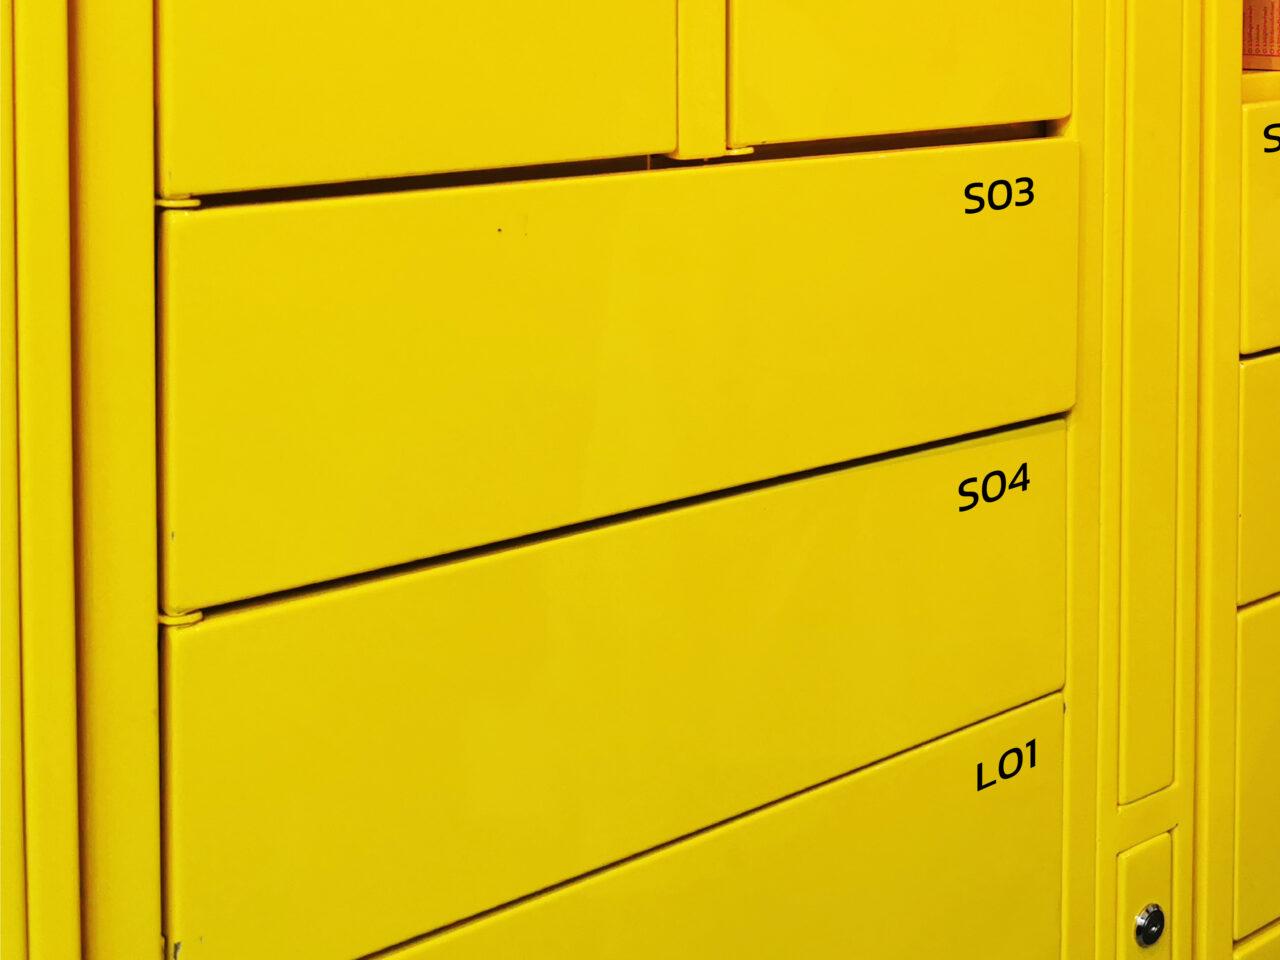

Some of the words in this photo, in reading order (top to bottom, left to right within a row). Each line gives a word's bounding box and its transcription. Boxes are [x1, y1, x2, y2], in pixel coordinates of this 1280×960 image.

[964, 176, 1035, 215] S03
[958, 462, 1031, 513] S04
[976, 738, 1036, 792] L01
